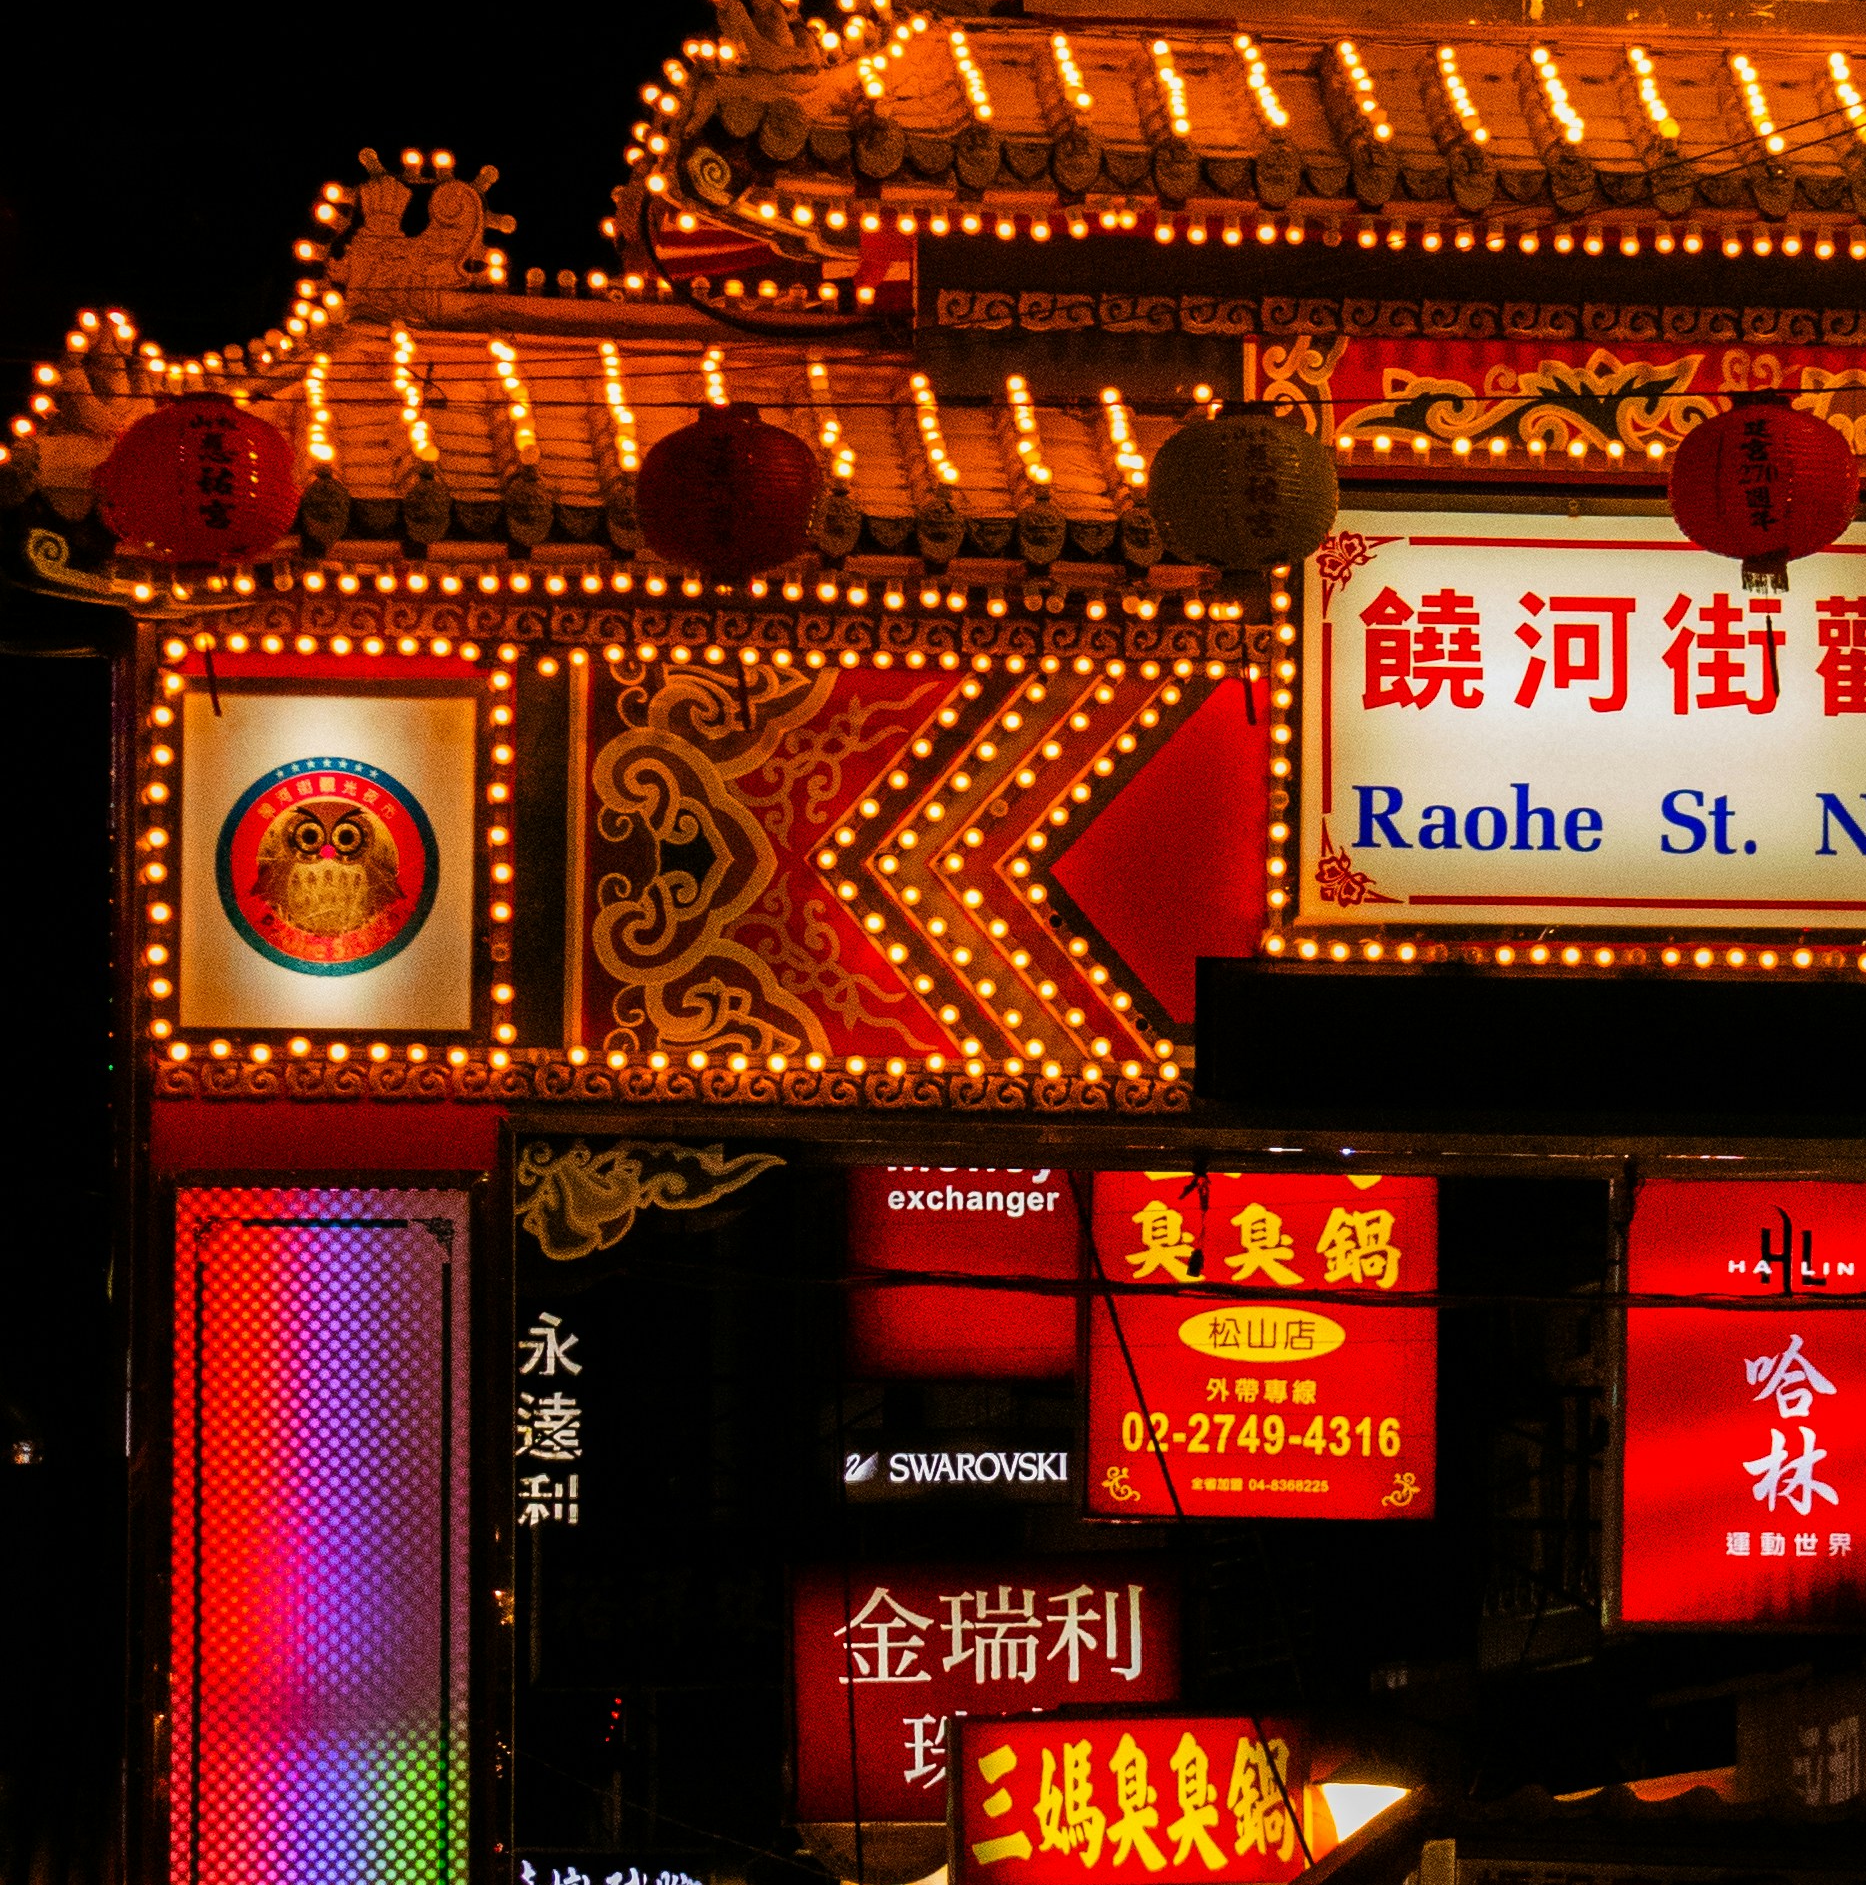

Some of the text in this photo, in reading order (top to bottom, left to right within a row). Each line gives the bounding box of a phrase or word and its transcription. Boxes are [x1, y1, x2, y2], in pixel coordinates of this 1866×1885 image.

[1352, 783, 1603, 852] Raohe
[1660, 789, 1757, 856] St.
[887, 1185, 1060, 1218] exchanger
[1125, 1200, 1403, 1290] 臭臭鍋
[1208, 1317, 1316, 1351] 松山店
[1206, 1379, 1317, 1404] 外帶專線
[1122, 1414, 1401, 1457] 02-2749-4316
[1742, 1334, 1839, 1516] 哈林
[889, 1452, 1068, 1483] SWAROVSKI
[1726, 1532, 1852, 1557] 運動世界
[833, 1584, 1144, 1685] 金瑞利
[972, 1731, 1297, 1873] 三媽臭臭鍋
